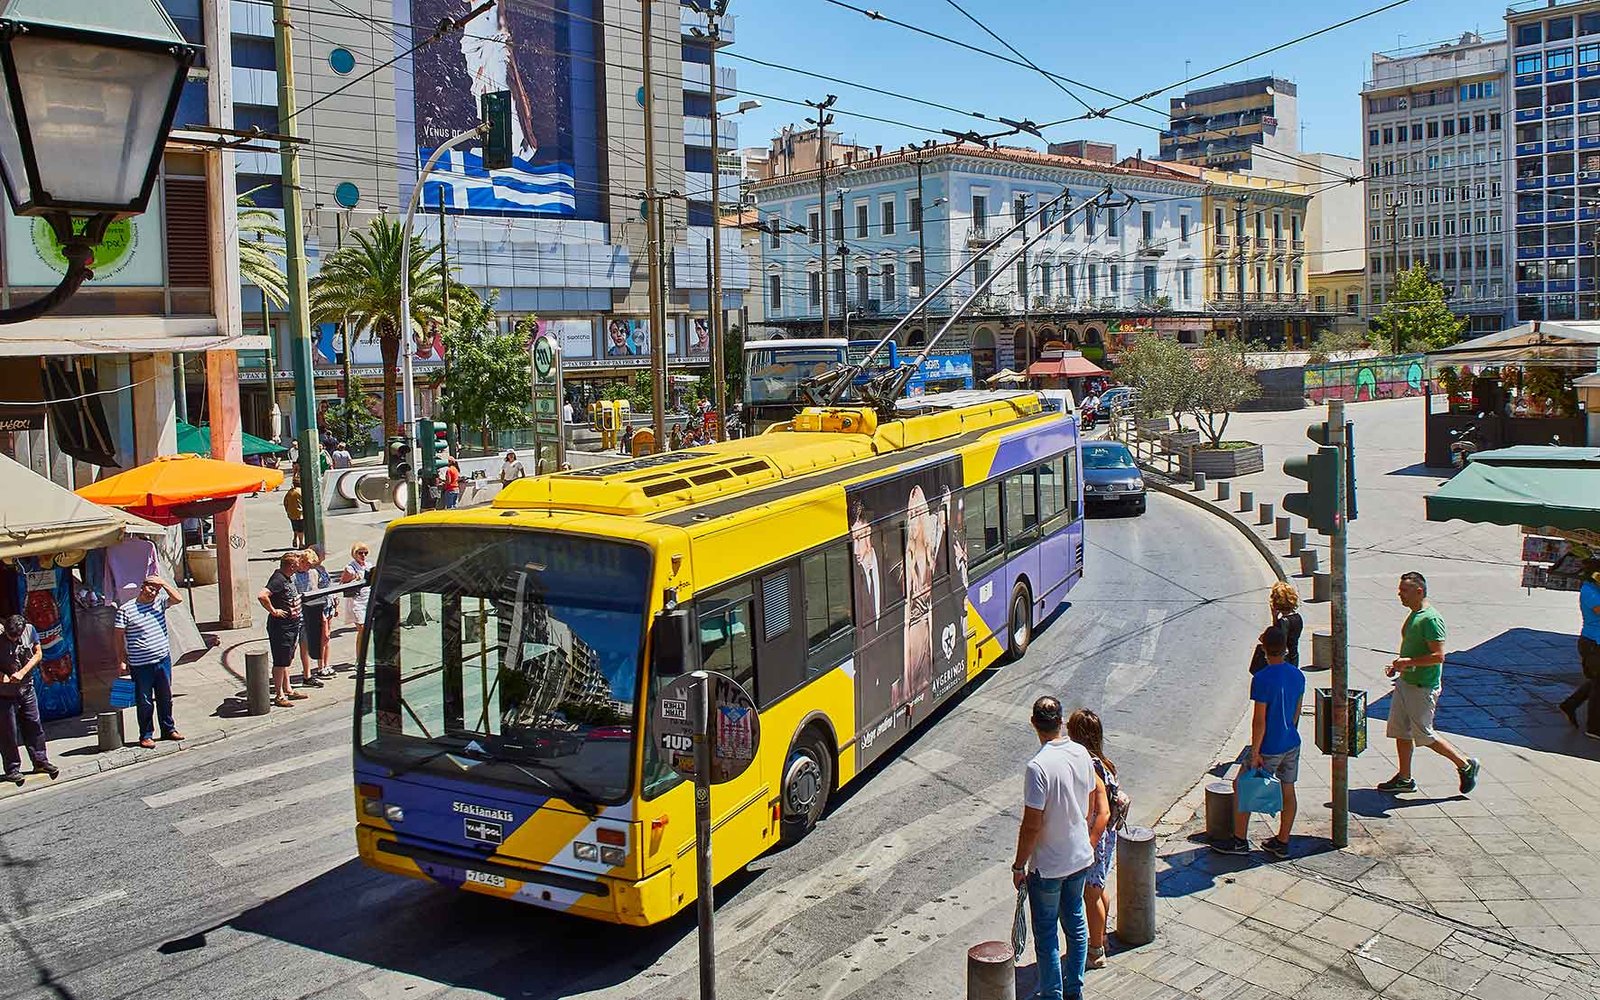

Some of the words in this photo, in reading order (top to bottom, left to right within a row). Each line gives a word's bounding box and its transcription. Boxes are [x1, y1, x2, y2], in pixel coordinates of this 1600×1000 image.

[423, 125, 450, 137] VENUS
[662, 735, 693, 751] 1UP
[453, 801, 513, 822] Sfakianakis
